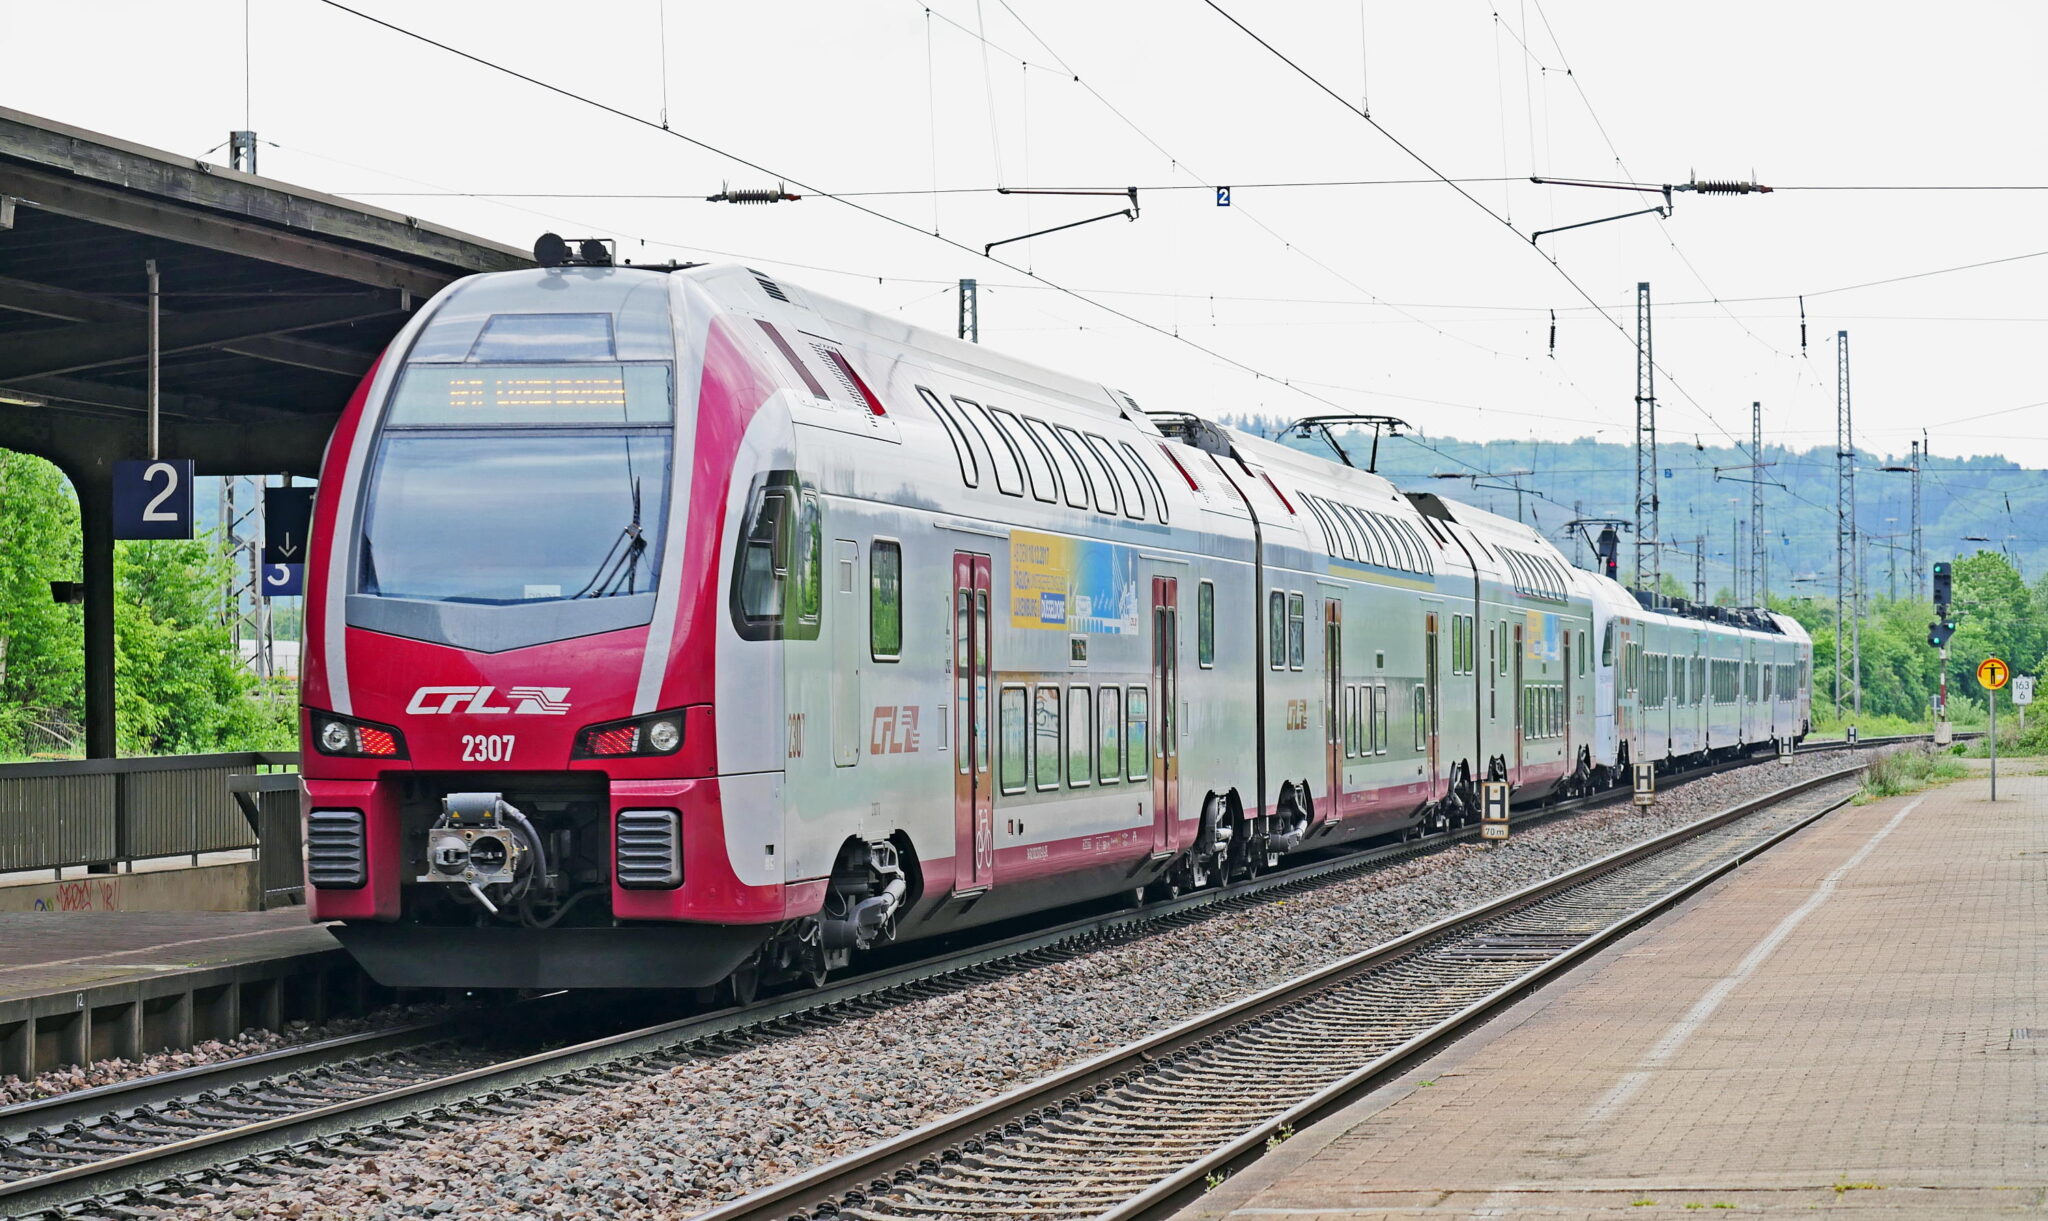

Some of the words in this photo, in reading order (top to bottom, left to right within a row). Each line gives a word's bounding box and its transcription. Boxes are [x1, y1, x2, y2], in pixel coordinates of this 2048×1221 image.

[1218, 188, 1229, 205] 2
[142, 462, 178, 522] 2
[2015, 681, 2030, 690] 163
[2019, 690, 2026, 700] 6
[405, 685, 511, 715] CFL
[788, 712, 806, 759] 2307
[870, 705, 903, 756] CFL
[1847, 728, 1857, 742] H
[461, 734, 516, 762] 2307
[1780, 736, 1792, 753] H
[1635, 765, 1651, 790] H
[1484, 785, 1506, 819] H
[1485, 827, 1495, 836] 70
